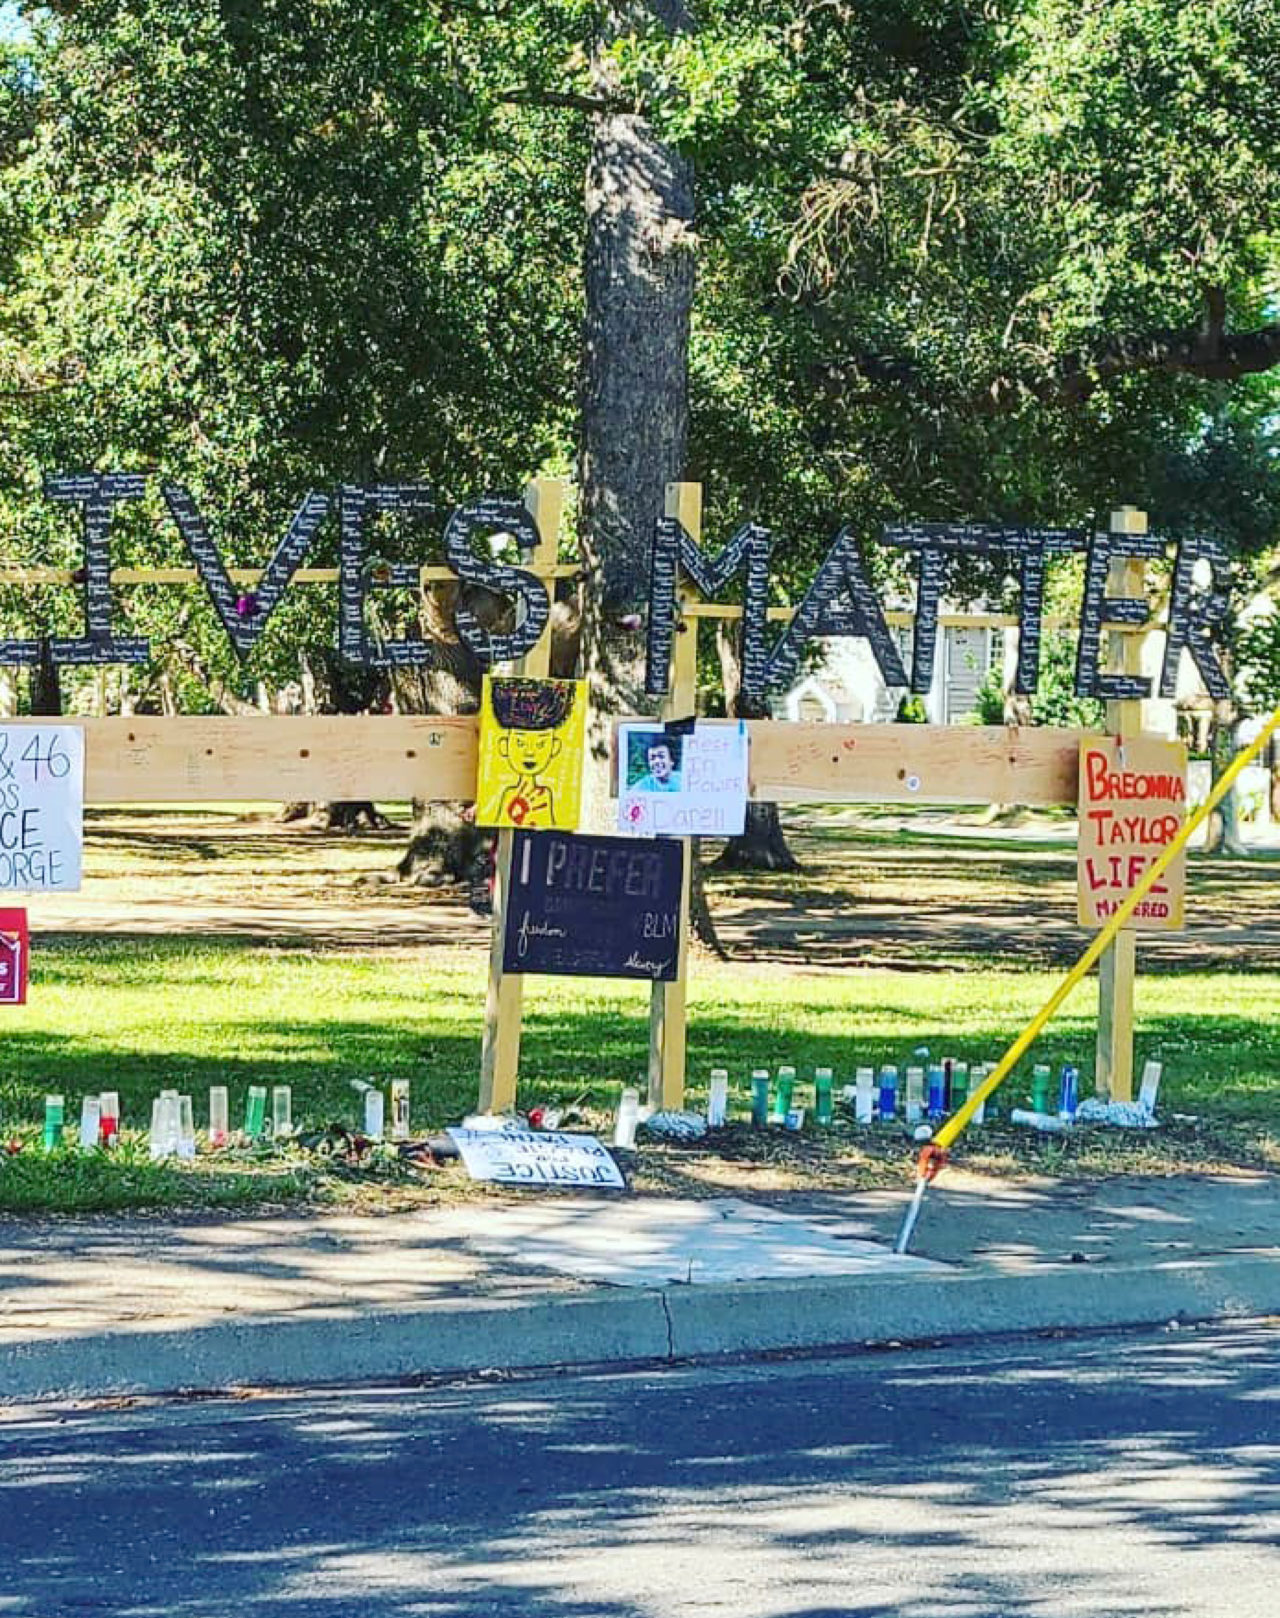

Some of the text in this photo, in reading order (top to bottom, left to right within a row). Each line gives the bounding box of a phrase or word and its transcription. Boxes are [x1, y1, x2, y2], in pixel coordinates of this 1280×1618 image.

[646, 517, 1233, 701] MATTER
[20, 733, 71, 782] 46
[1086, 751, 1186, 803] BREONNA
[1087, 810, 1179, 846] TAYLOR
[520, 838, 532, 885] I
[643, 912, 677, 938] BLM
[494, 1162, 616, 1183] JUSTICE
